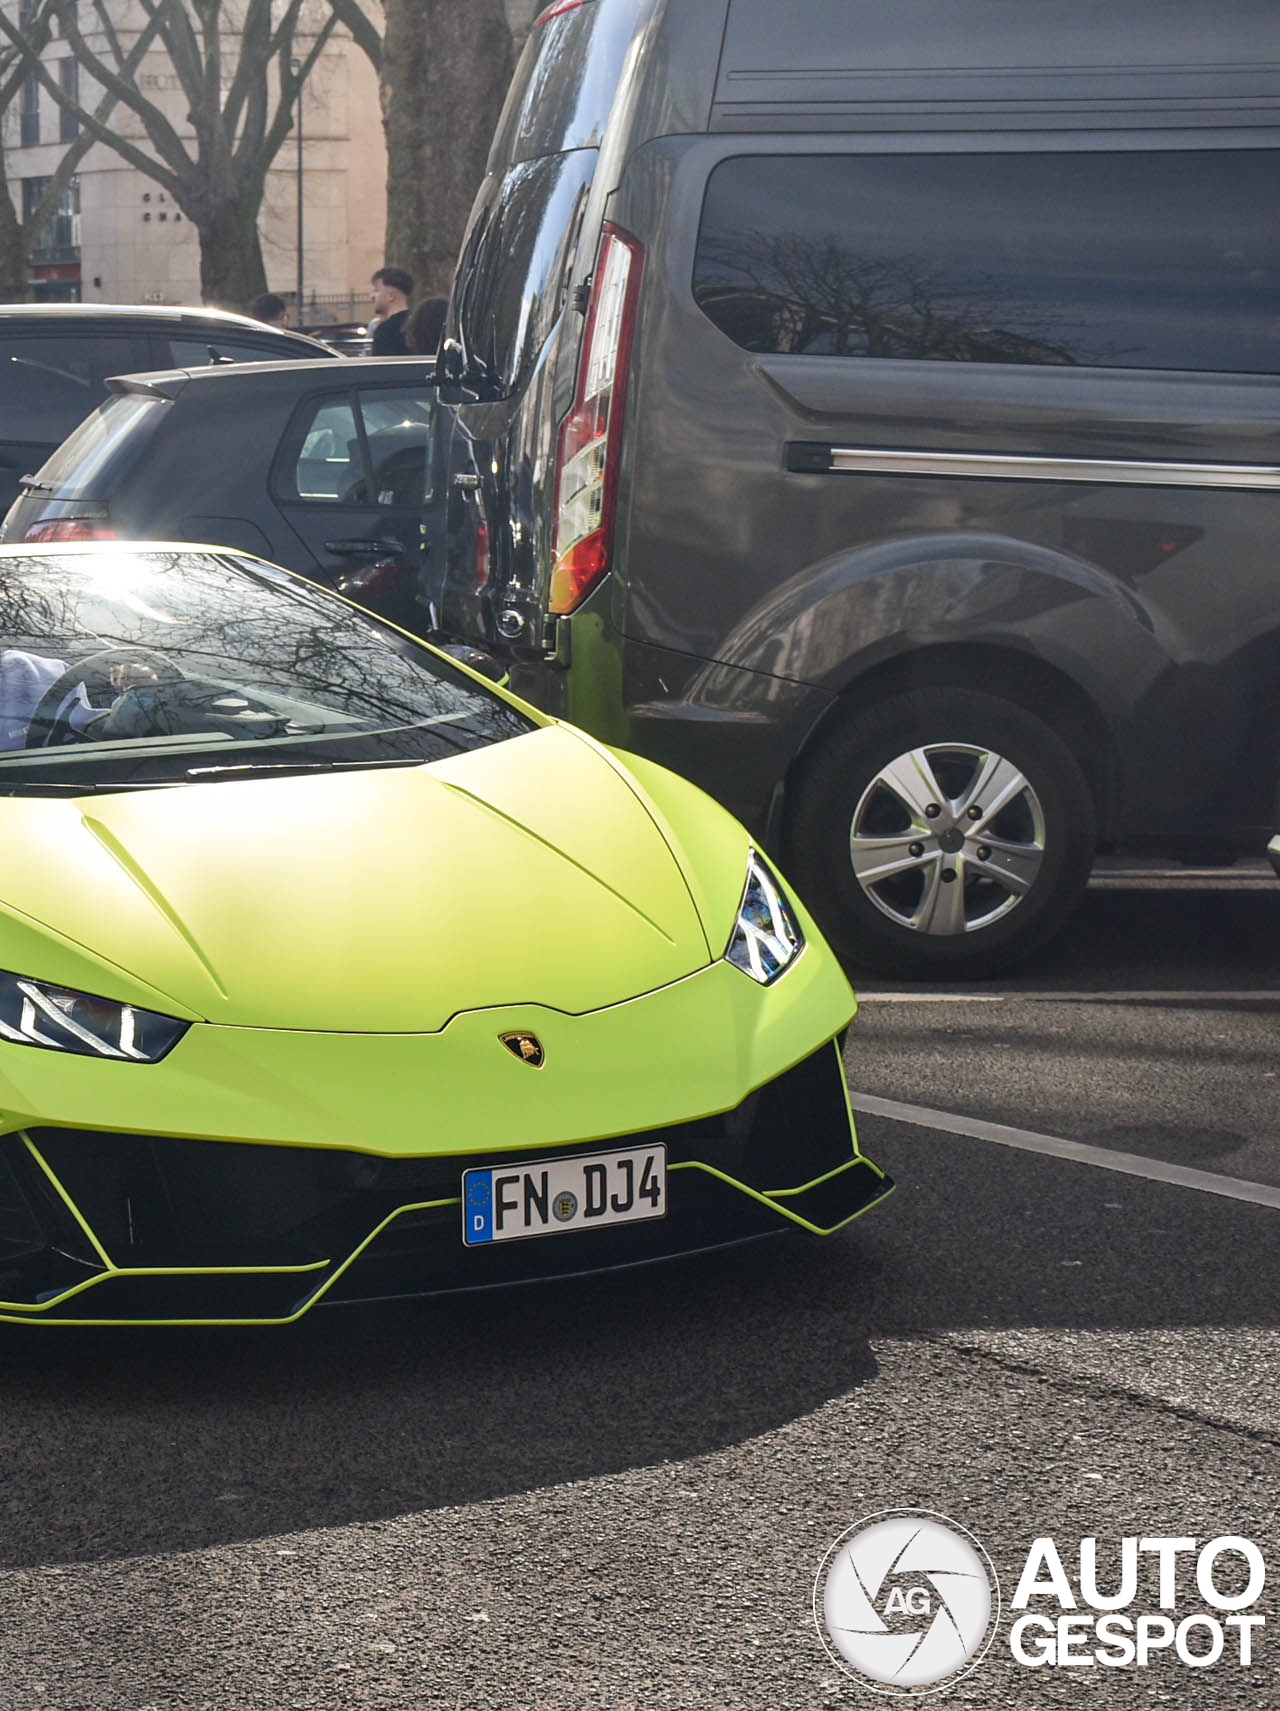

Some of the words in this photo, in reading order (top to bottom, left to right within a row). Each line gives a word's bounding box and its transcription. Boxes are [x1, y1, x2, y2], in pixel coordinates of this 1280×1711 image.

[495, 1171, 549, 1231] FN
[583, 1155, 661, 1218] DJ4
[473, 1215, 485, 1231] D
